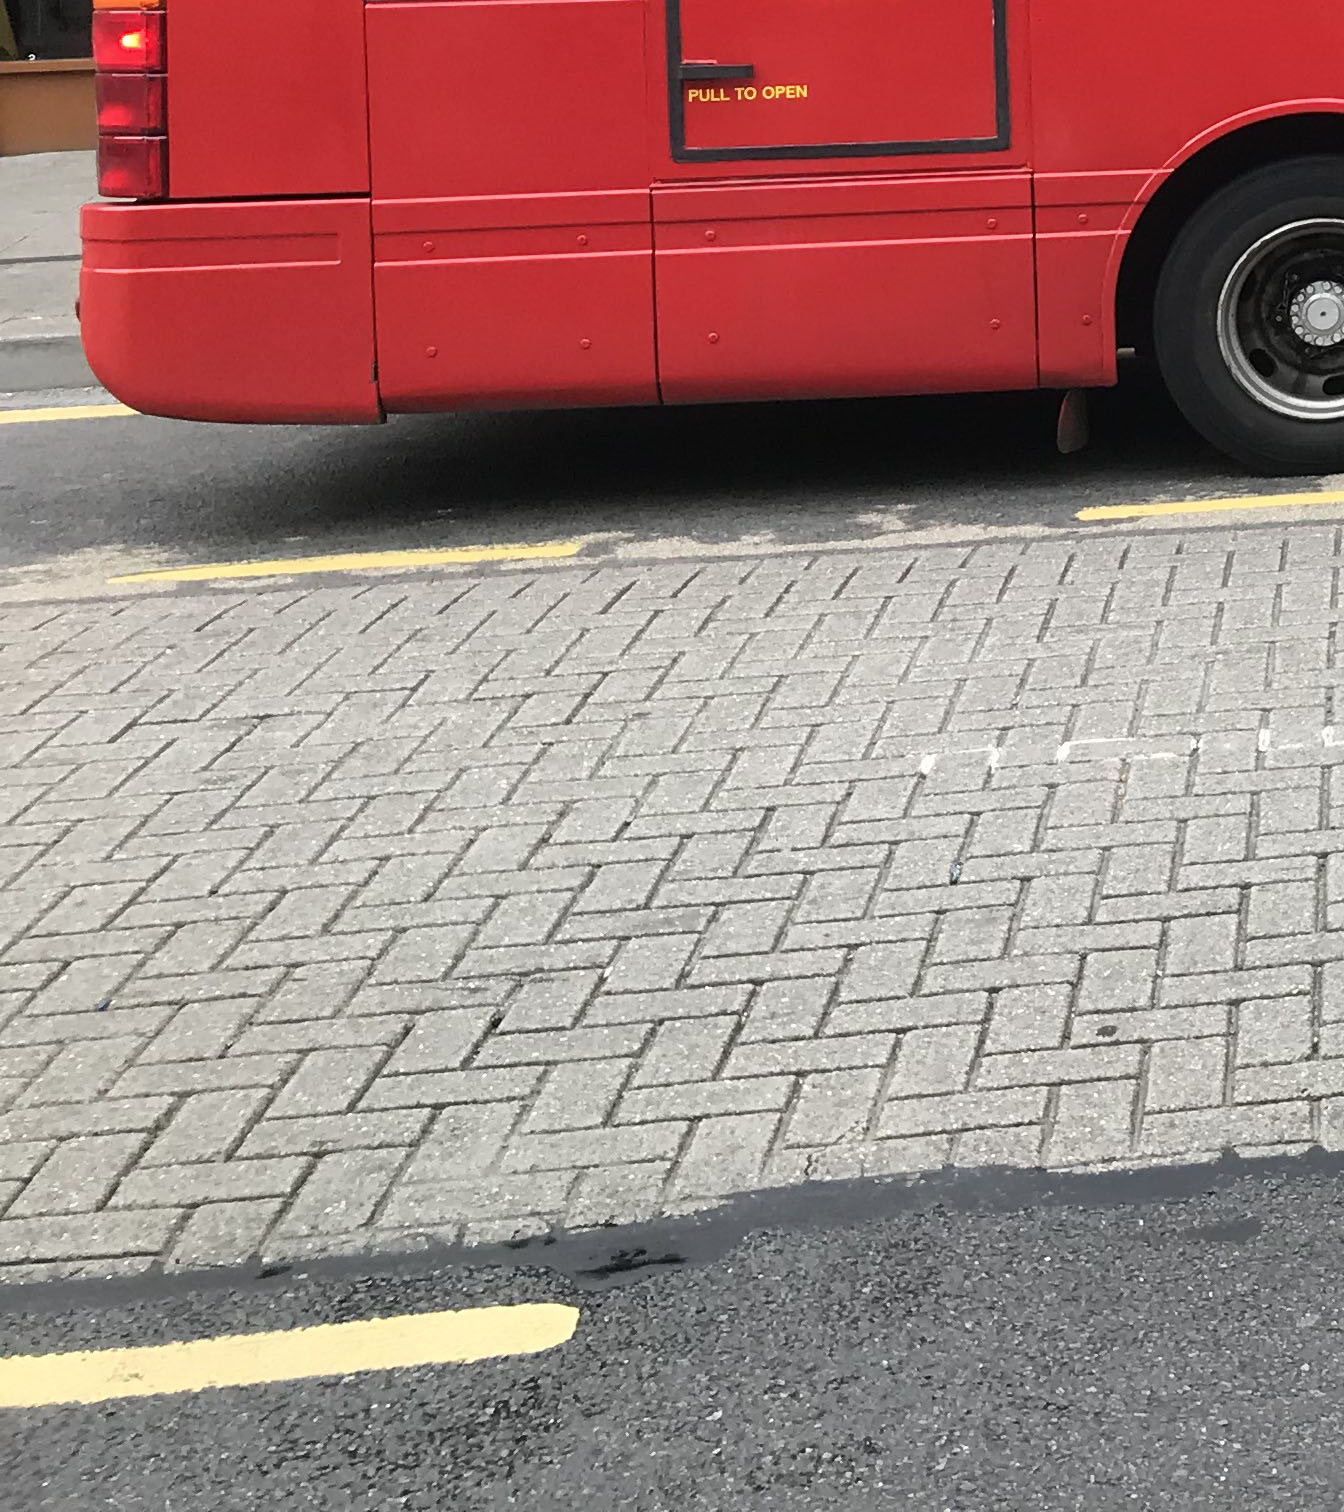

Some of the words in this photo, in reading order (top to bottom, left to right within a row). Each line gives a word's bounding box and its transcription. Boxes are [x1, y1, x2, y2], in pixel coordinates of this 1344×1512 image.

[688, 87, 730, 102] PULL
[735, 87, 757, 101] TO
[762, 85, 808, 99] OPEN
